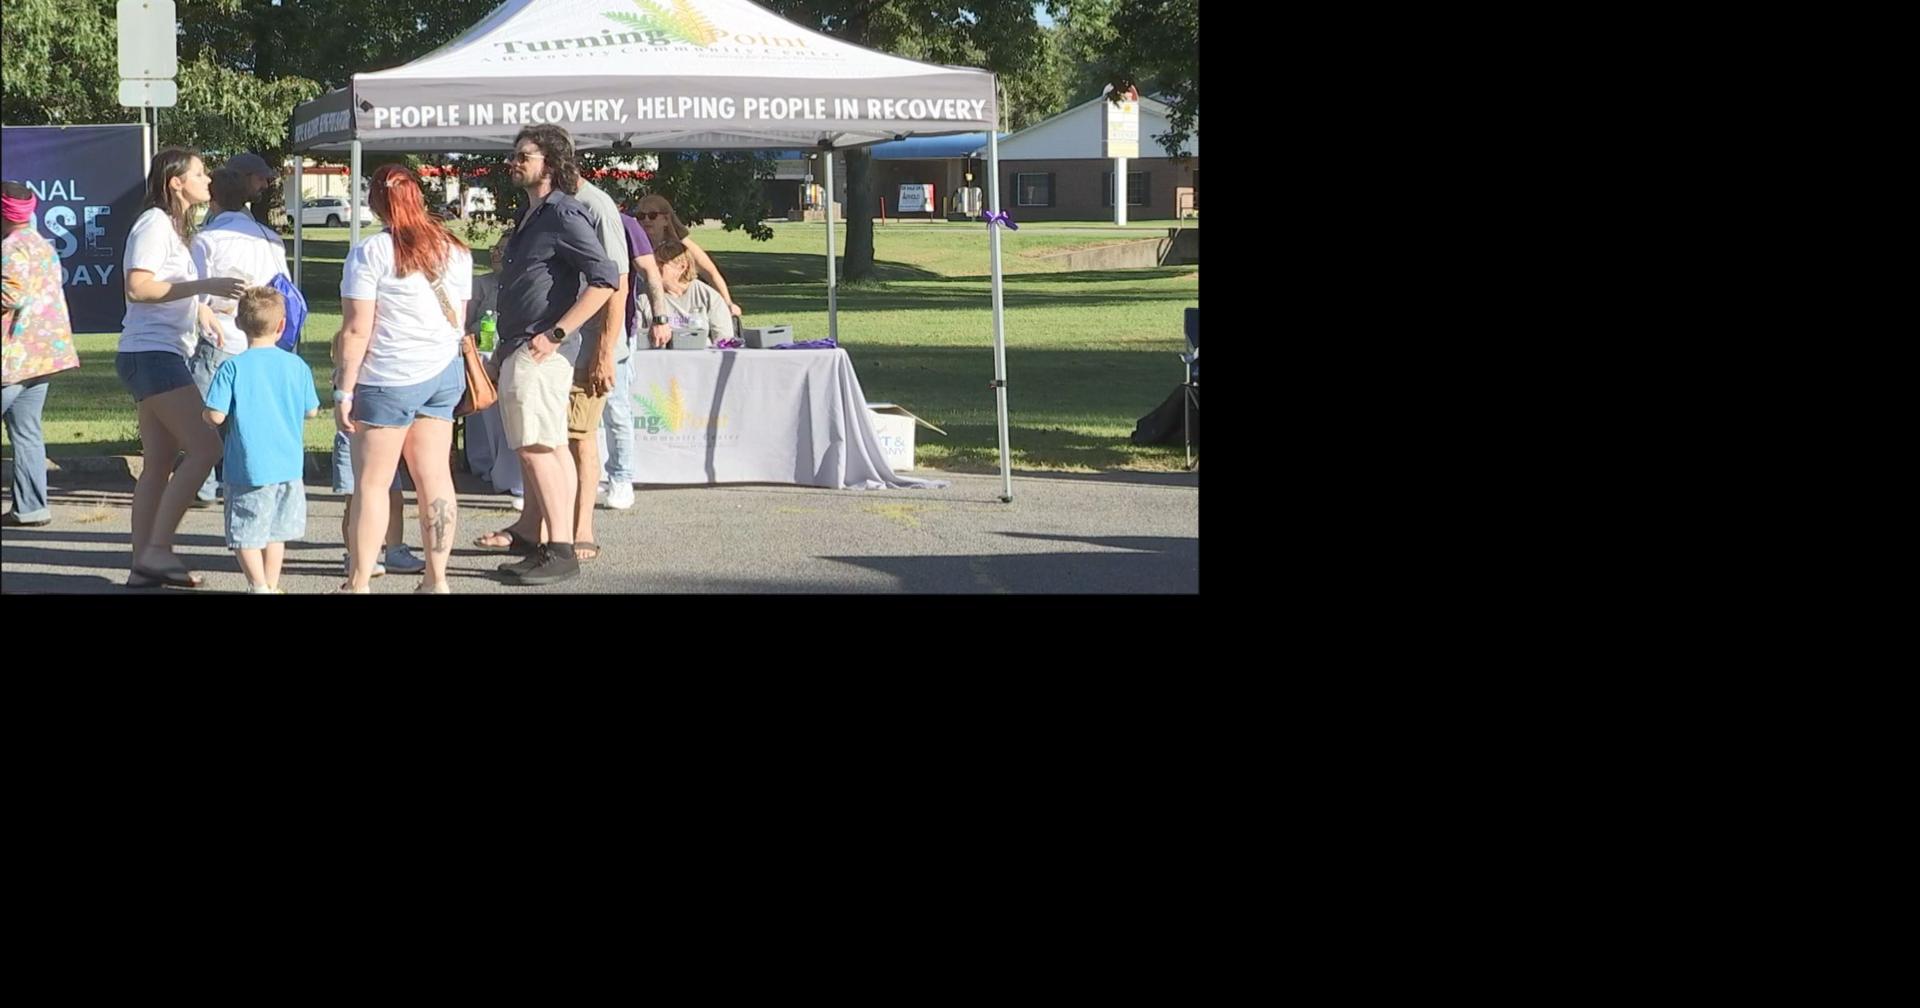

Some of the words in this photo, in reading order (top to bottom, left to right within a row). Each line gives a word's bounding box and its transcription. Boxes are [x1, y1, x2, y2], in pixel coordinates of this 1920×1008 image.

[494, 30, 671, 54] Turning
[707, 29, 807, 48] Point
[374, 105, 459, 128] PEOPLE
[469, 103, 493, 126] IN
[502, 98, 629, 125] RECOVERY,
[637, 97, 735, 121] HELPING
[744, 97, 826, 120] PEOPLE
[834, 98, 859, 120] IN
[867, 98, 986, 120] RECOVERY
[26, 180, 85, 201] NAL
[30, 205, 113, 257] SE
[880, 435, 892, 447] T
